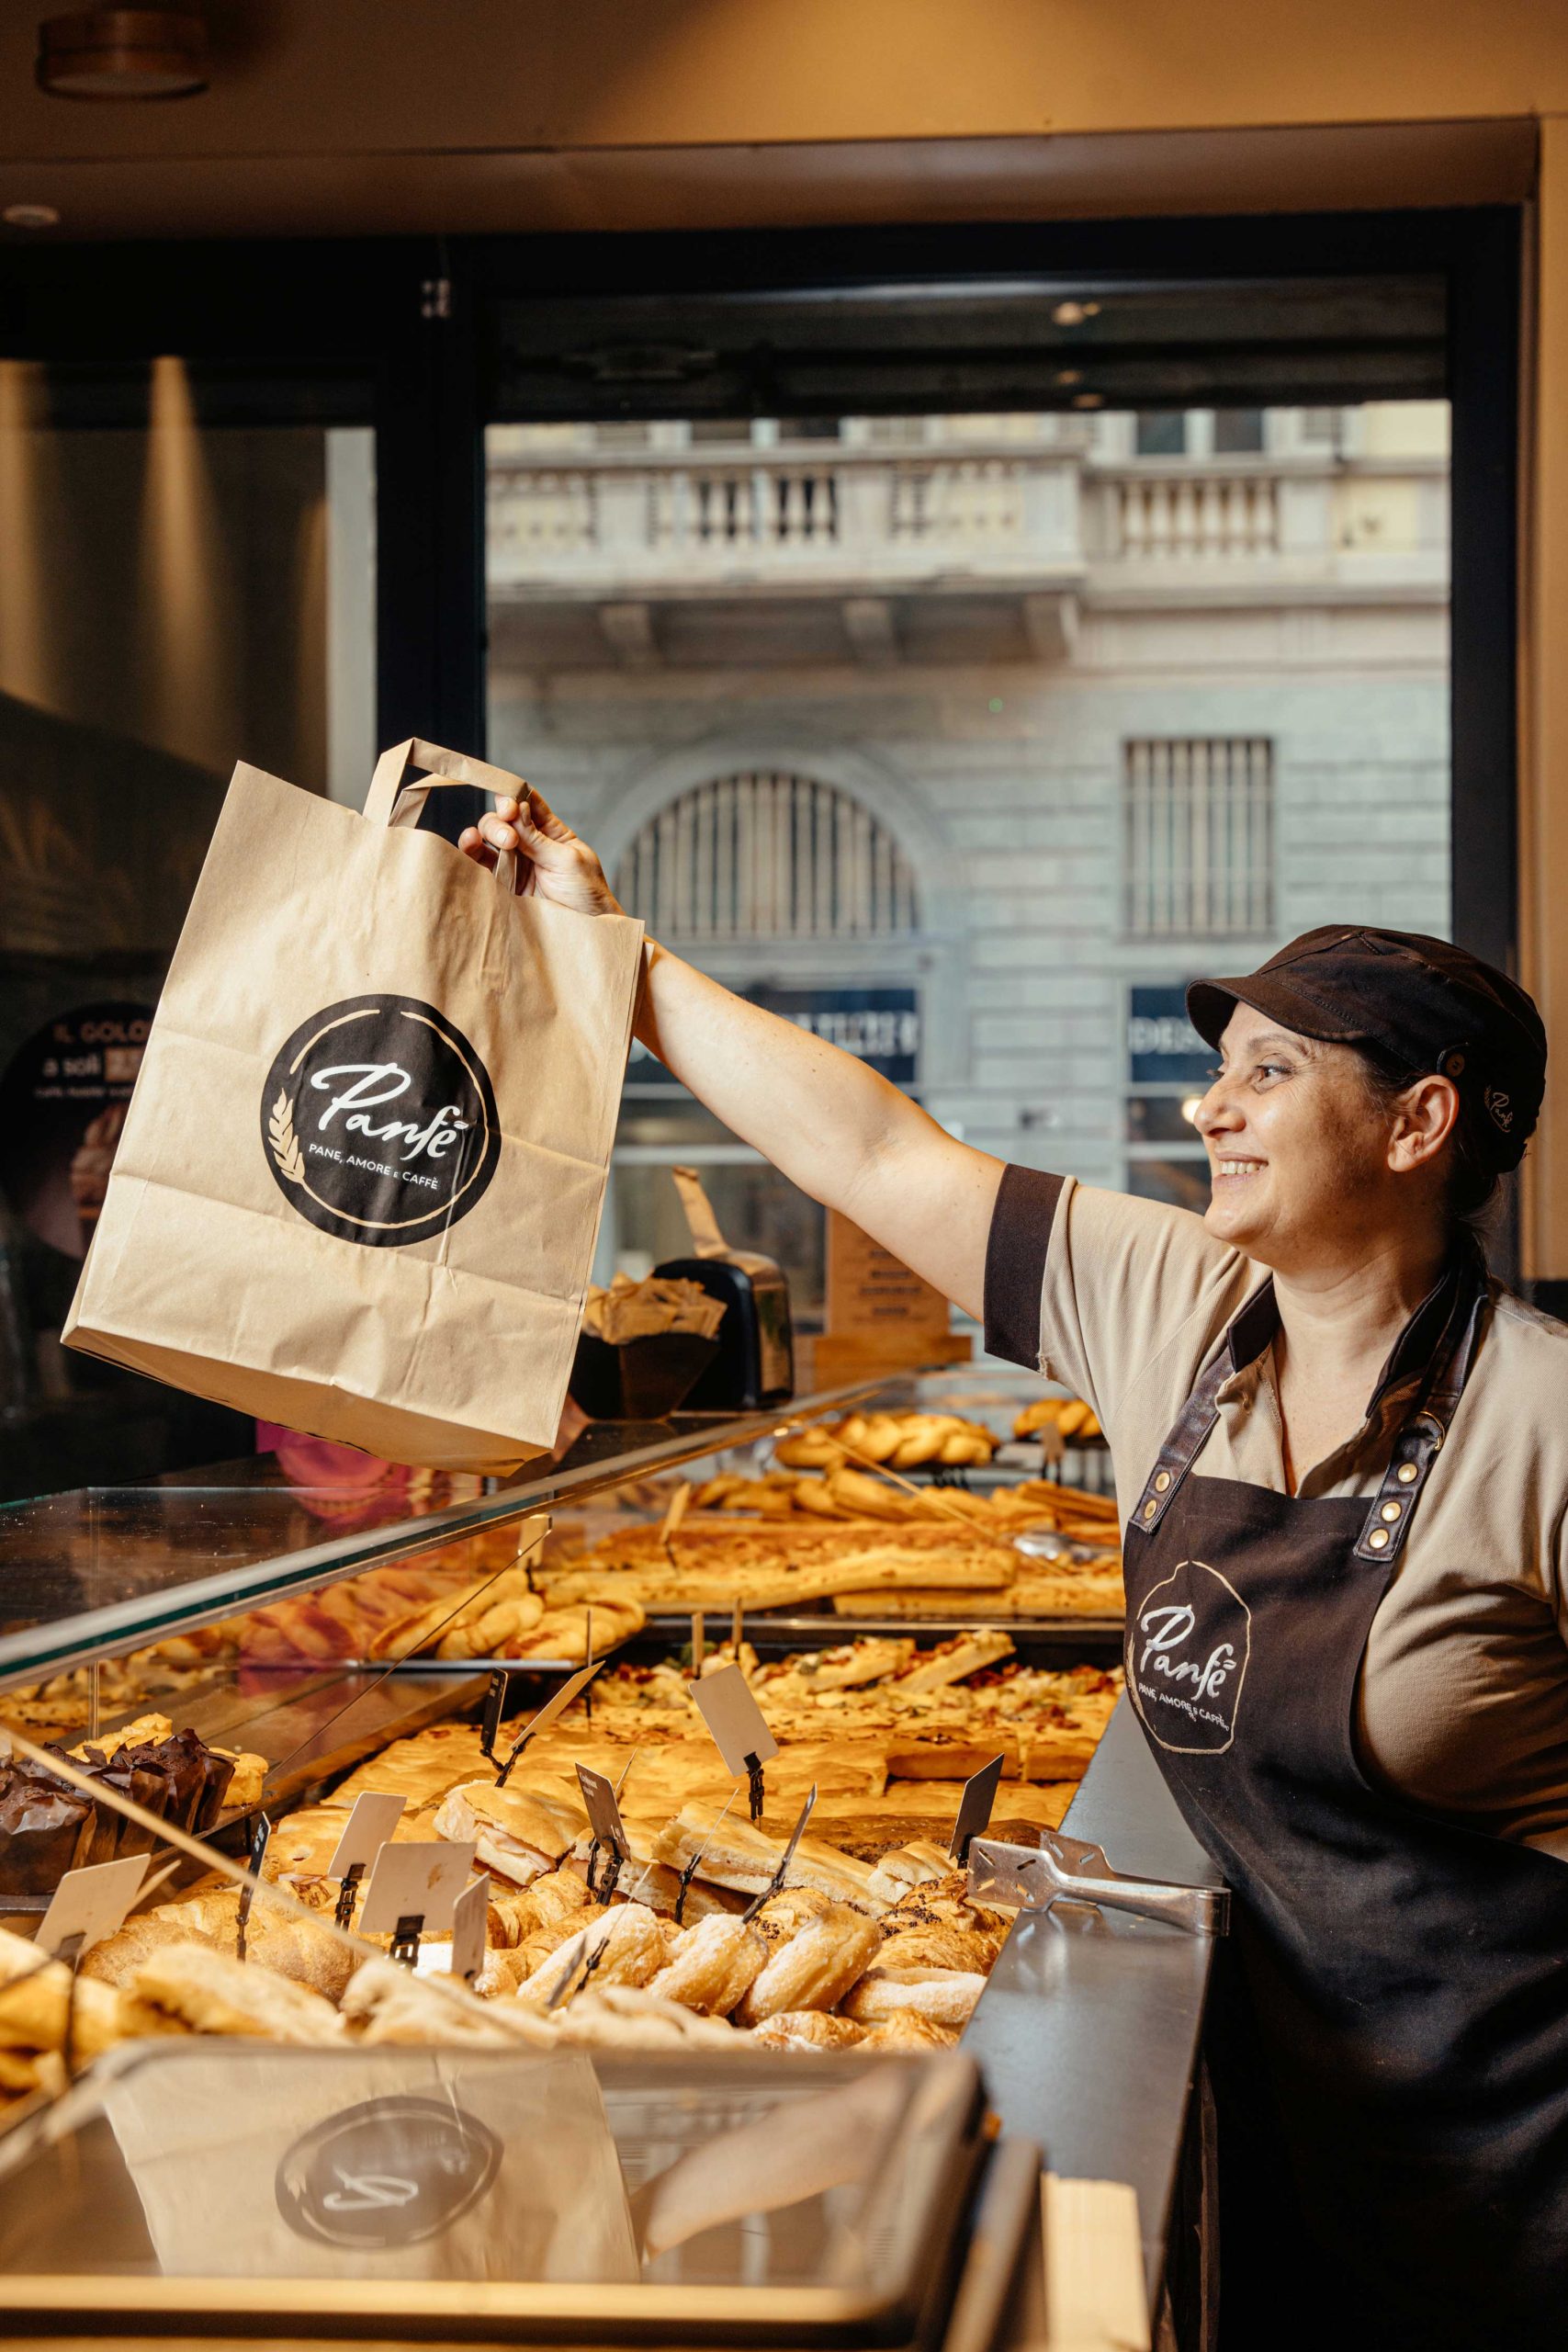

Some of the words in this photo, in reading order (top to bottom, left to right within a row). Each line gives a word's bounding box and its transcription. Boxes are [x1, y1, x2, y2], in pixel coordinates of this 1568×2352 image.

[309, 1143, 344, 1164] PANE,
[346, 1154, 391, 1176] AMORE
[401, 1170, 439, 1190] CAFFÈ
[1138, 1682, 1157, 1702] PANE,
[1159, 1692, 1192, 1713] AMORE
